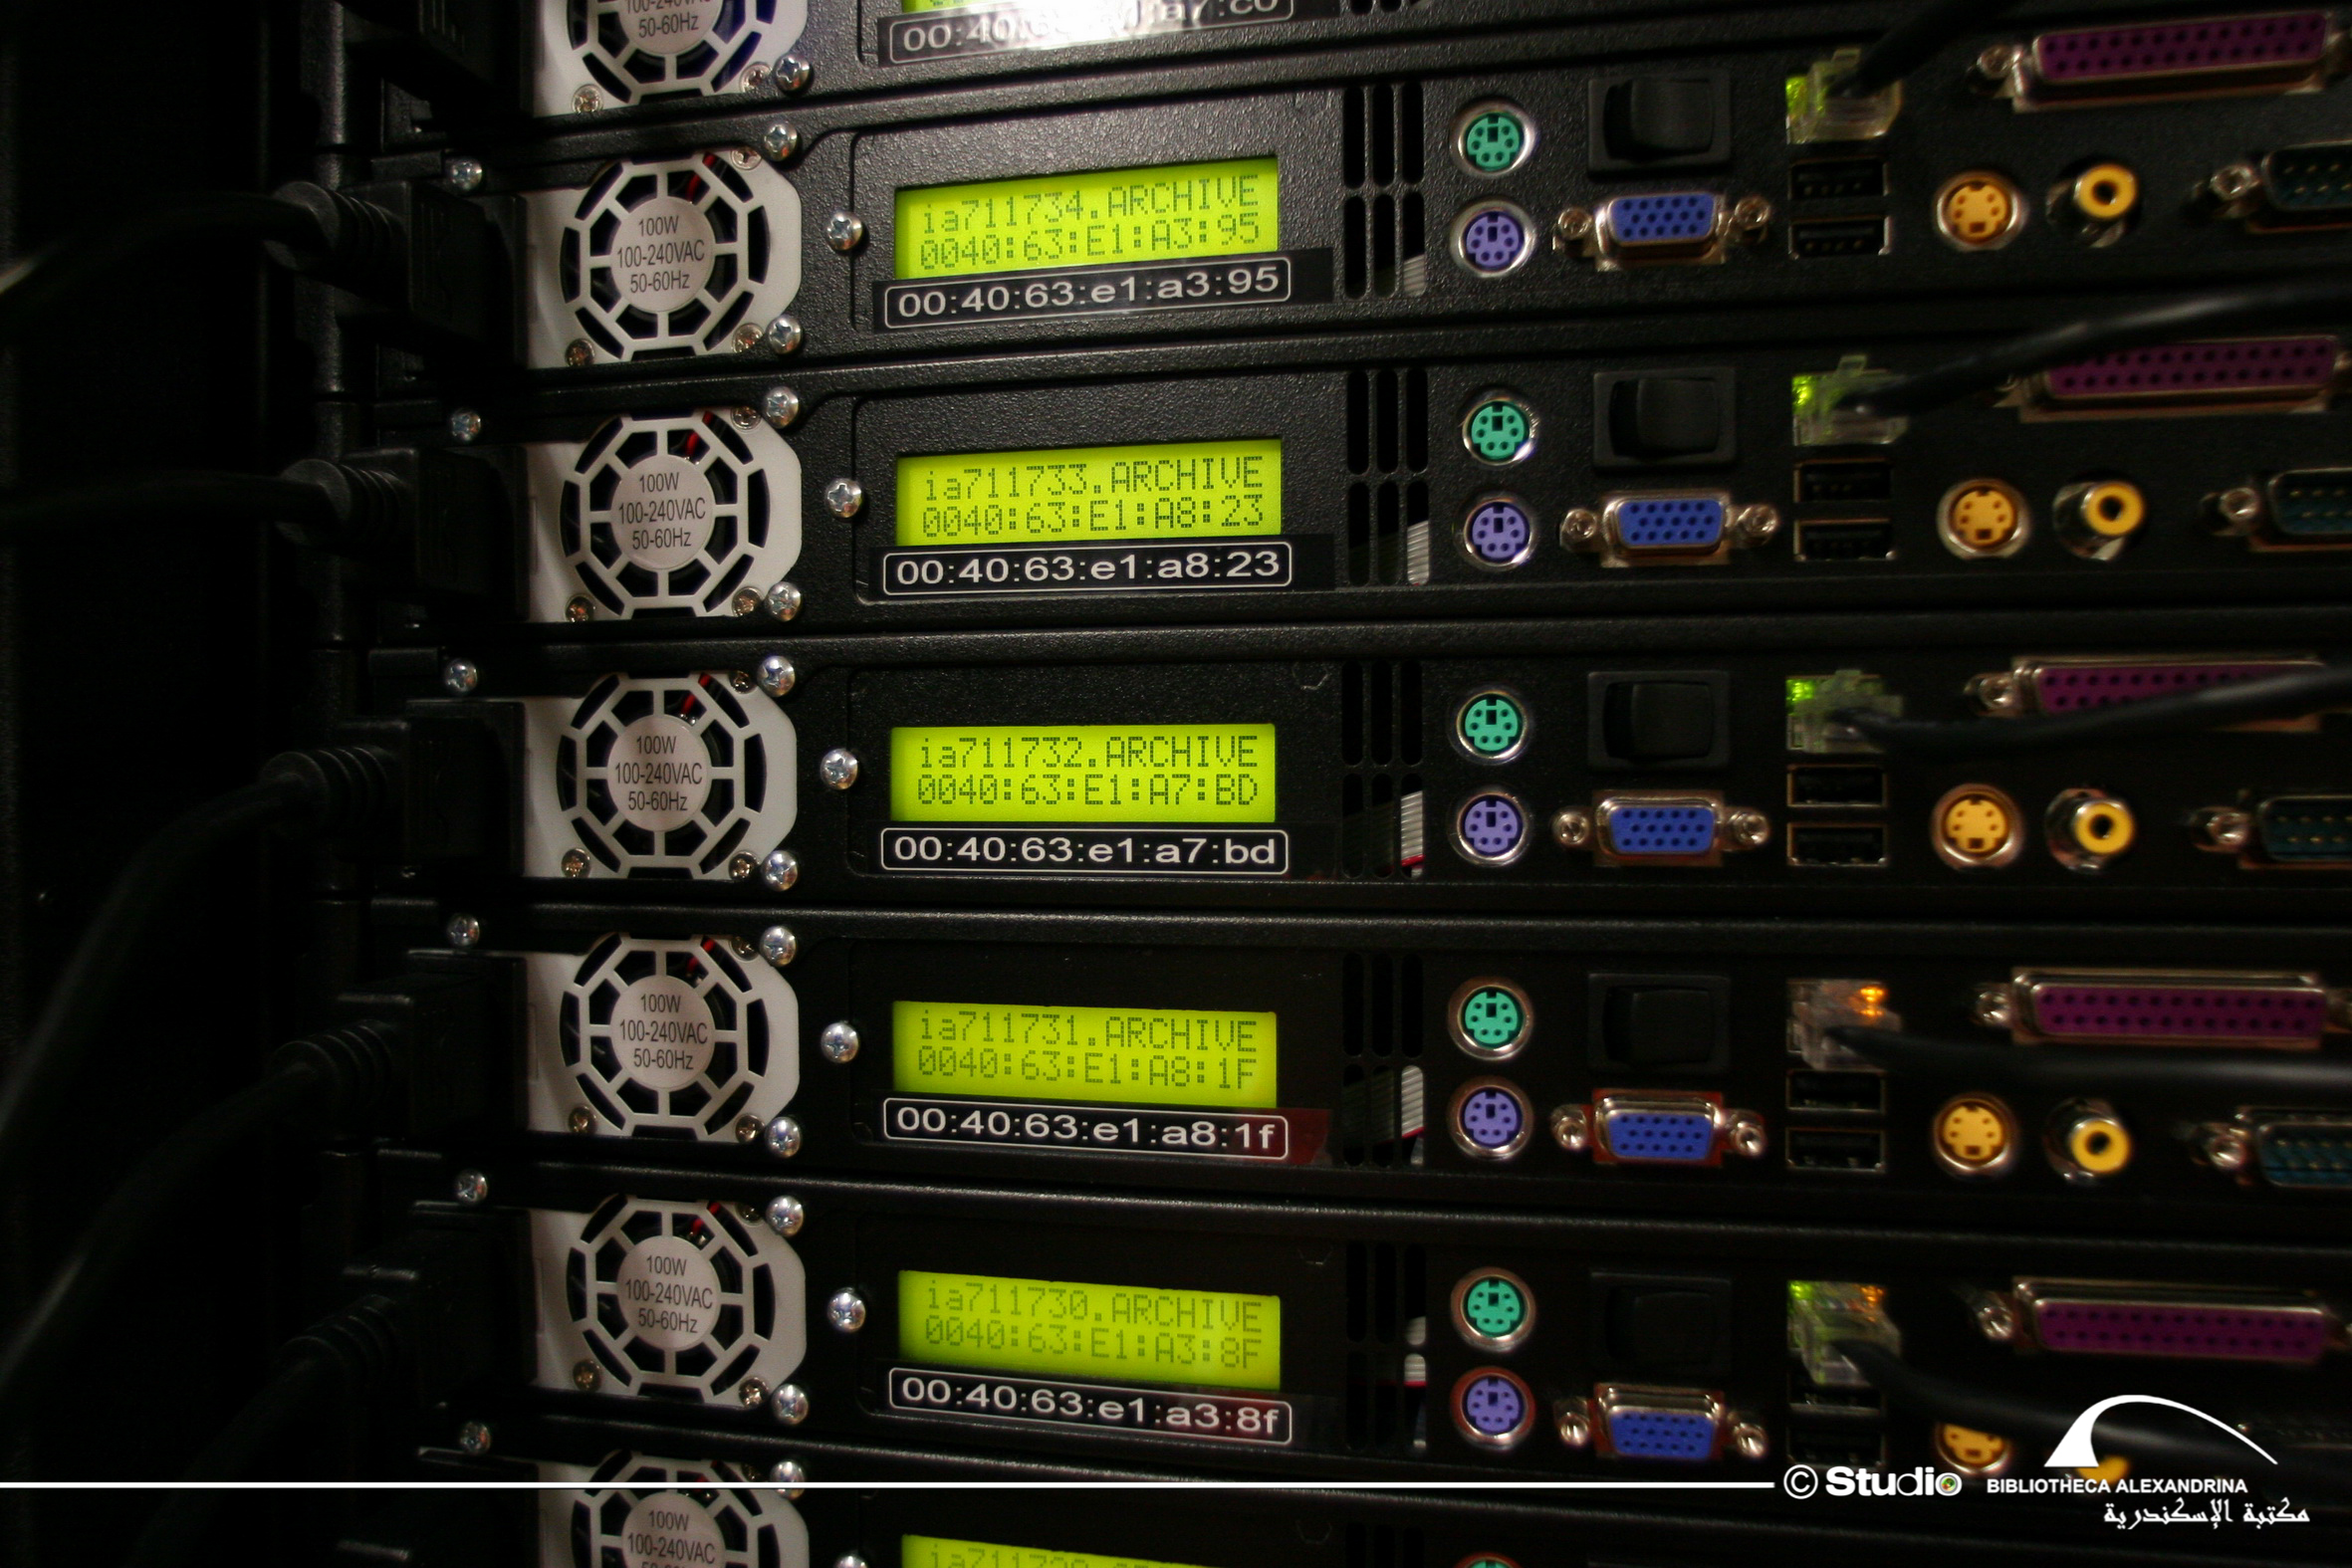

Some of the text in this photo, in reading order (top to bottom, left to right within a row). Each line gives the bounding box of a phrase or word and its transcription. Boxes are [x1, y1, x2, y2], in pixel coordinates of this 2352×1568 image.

[638, 12, 699, 38] 50-60Hz
[923, 174, 1259, 234] ia711734.ARCHIVE
[639, 215, 679, 237] 100W
[920, 212, 1260, 270] 0040:63:E1:A3:95
[617, 239, 705, 269] 100-240VAC
[630, 270, 690, 293] 50-60Hz
[898, 266, 1280, 318] 00:40:63:e1:a3:95
[639, 472, 679, 493] 100W
[926, 456, 1264, 501] ia711733.ARCHIVE
[618, 497, 706, 525] 100-240VAC
[922, 495, 1264, 538] 0040:63:E1:A8:23
[632, 528, 691, 550] 50-60Hz
[896, 551, 1280, 585] 00:40:63:e1:a8:23
[636, 736, 676, 755] 100W
[921, 736, 1258, 769] ia711732.ARCHIVE
[615, 763, 703, 784] 100-240VAC
[628, 791, 688, 811] 50-60Hz
[917, 774, 1258, 805] 0040:63:E1:A7:BD
[894, 836, 1275, 864] 00:40:63:e1:a7:bd
[640, 994, 681, 1013] 100W
[620, 1018, 708, 1044] 100-240VAC
[921, 1009, 1257, 1052] ia711731.ARCHIVE
[633, 1048, 694, 1070] 50-60Hz
[917, 1045, 1257, 1089] 0040:63:E1:A8:1F
[897, 1106, 1276, 1149] 00:40:63:e1:a8:1f
[646, 1255, 687, 1276] 100W
[625, 1278, 713, 1309] 100-240VAC
[928, 1280, 1262, 1333] ia711730.ARCHIVE
[638, 1307, 697, 1334] 50-60Hz
[926, 1315, 1262, 1369] 0040:63:E1:A3:8F
[902, 1377, 1279, 1434] 00:40:63:e1:a3:8f
[649, 1509, 689, 1531] 100W
[628, 1532, 715, 1564] 100-240VAC
